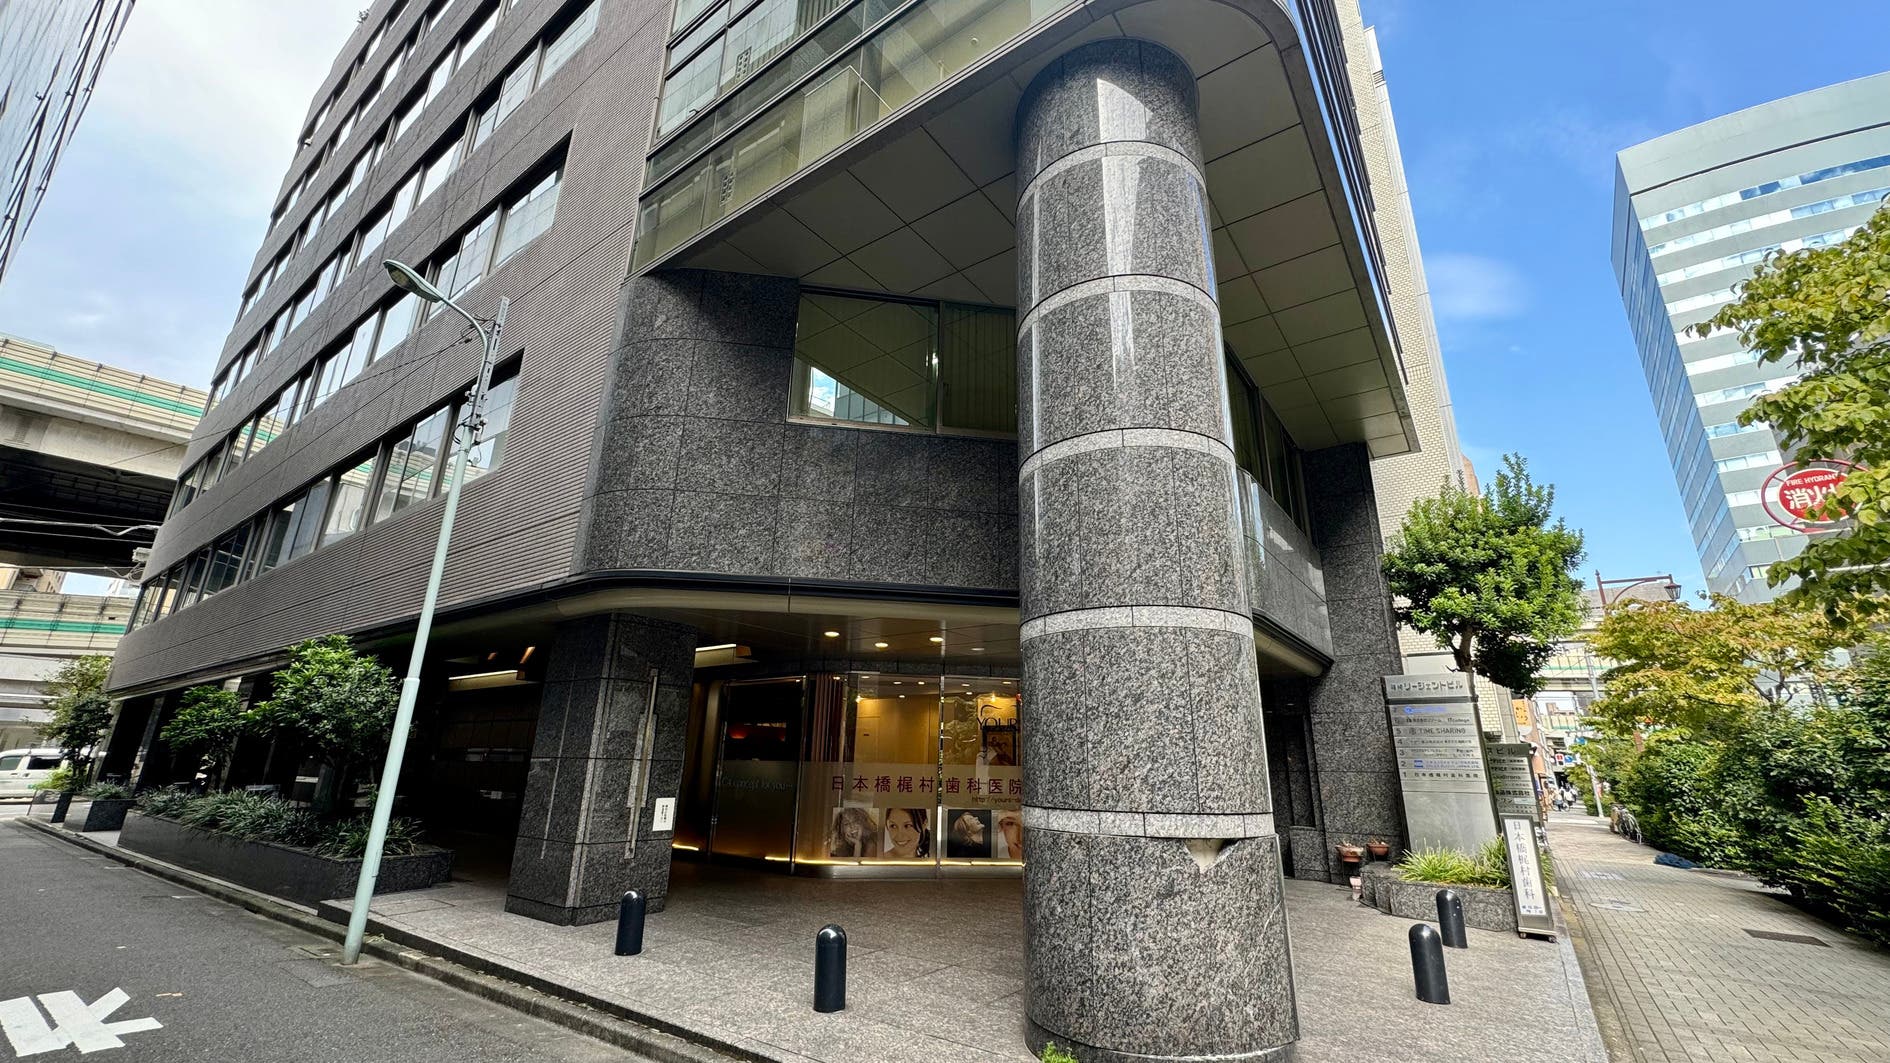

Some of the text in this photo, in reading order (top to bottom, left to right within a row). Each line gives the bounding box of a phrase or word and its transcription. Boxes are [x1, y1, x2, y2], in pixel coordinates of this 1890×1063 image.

[1786, 478, 1804, 487] FIRE
[1783, 483, 1837, 510] 消火
[1418, 727, 1435, 735] TIME
[1436, 727, 1467, 735] SHARING
[831, 775, 1022, 796] 日本橋梶村歯科医院
[1513, 820, 1536, 900] 日本橋梶村歯科
